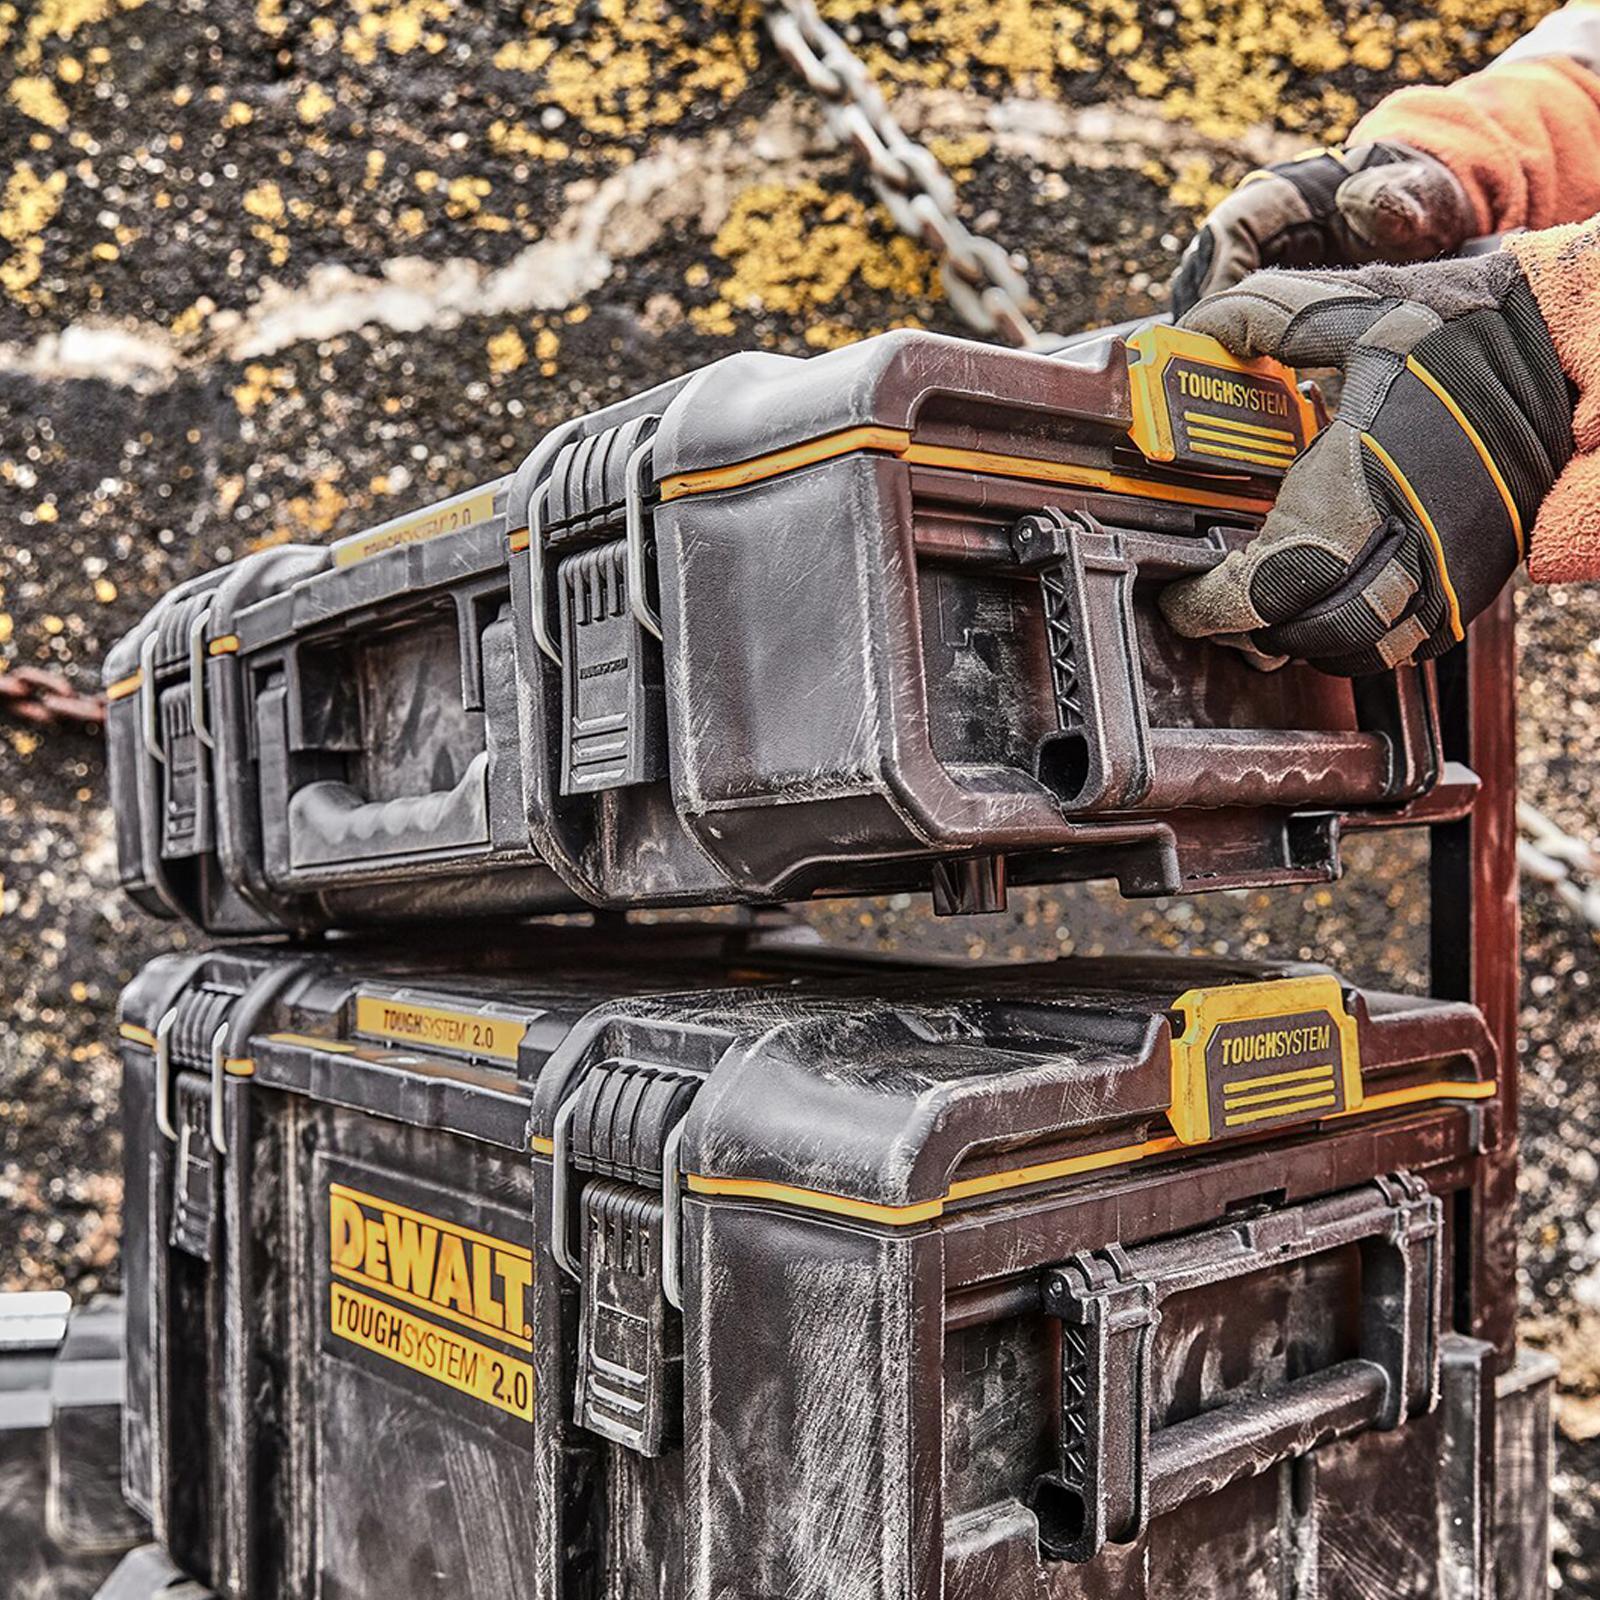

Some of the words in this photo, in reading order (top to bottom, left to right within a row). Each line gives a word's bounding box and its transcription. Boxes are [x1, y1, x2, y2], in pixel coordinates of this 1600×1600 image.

[1177, 370, 1288, 417] TOUGHSYSTEM
[384, 1009, 467, 1043] TOUGHSYSTEM
[472, 1024, 494, 1049] 2.0
[1221, 1025, 1331, 1066] TOUGHSYSTEM
[337, 1293, 479, 1388] TOUGHSYSTEM
[491, 1361, 528, 1410] 2.0
